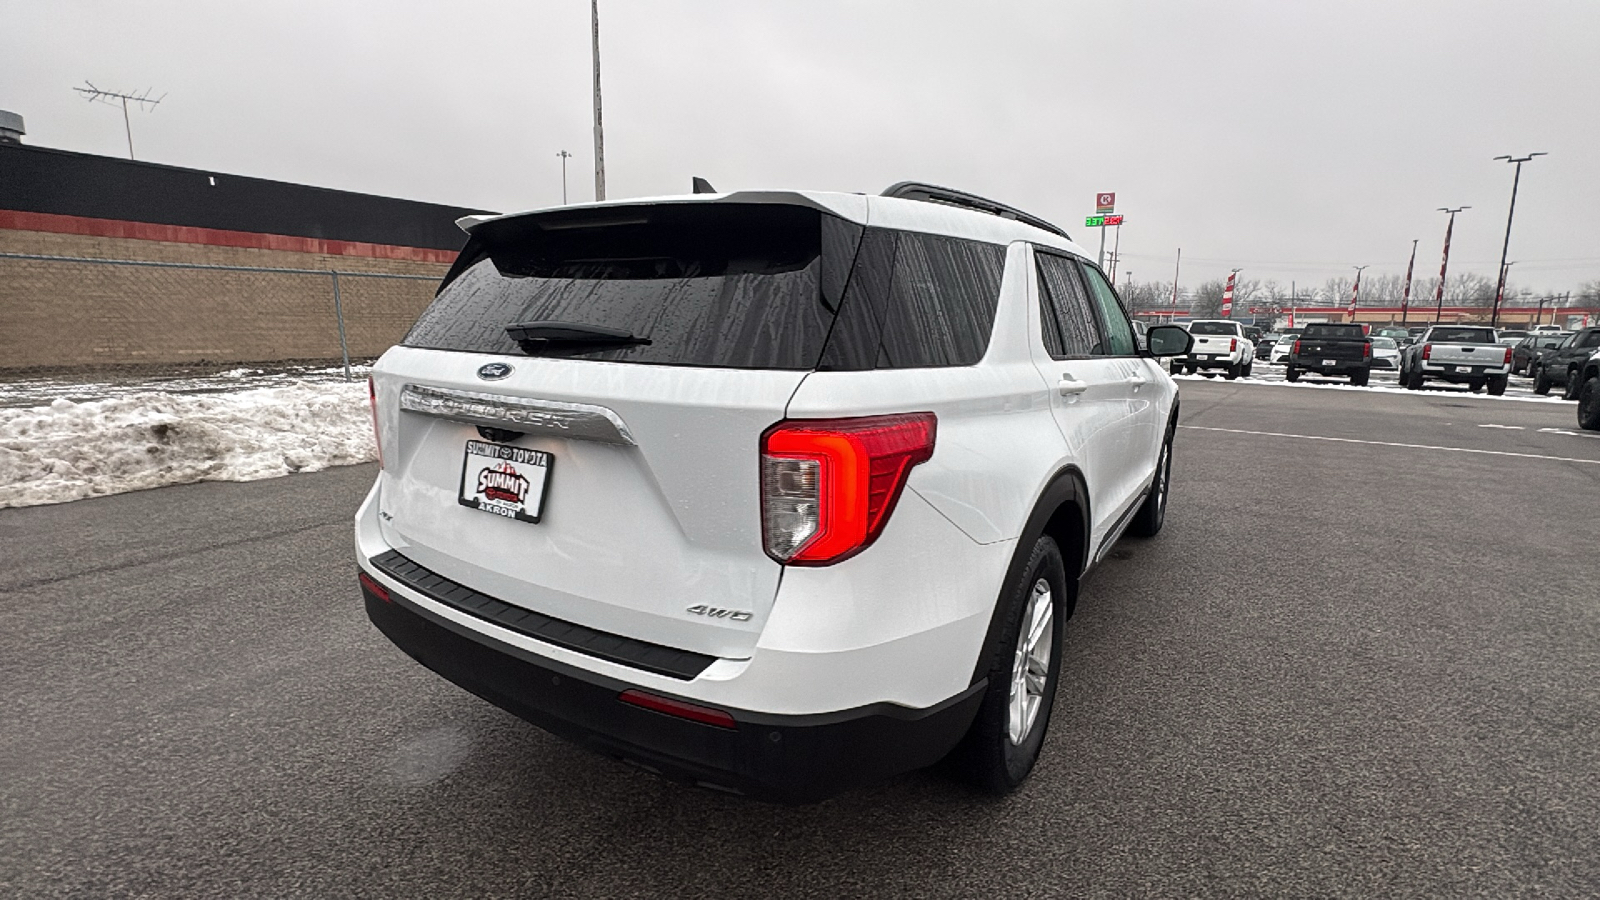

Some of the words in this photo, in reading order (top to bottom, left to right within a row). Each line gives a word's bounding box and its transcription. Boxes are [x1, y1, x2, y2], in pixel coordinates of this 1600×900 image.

[467, 441, 500, 459] SUMMIT
[512, 448, 548, 467] TOYOTA
[478, 469, 528, 501] SUMMIT
[478, 502, 516, 518] AKRON
[686, 604, 753, 622] 4WD
